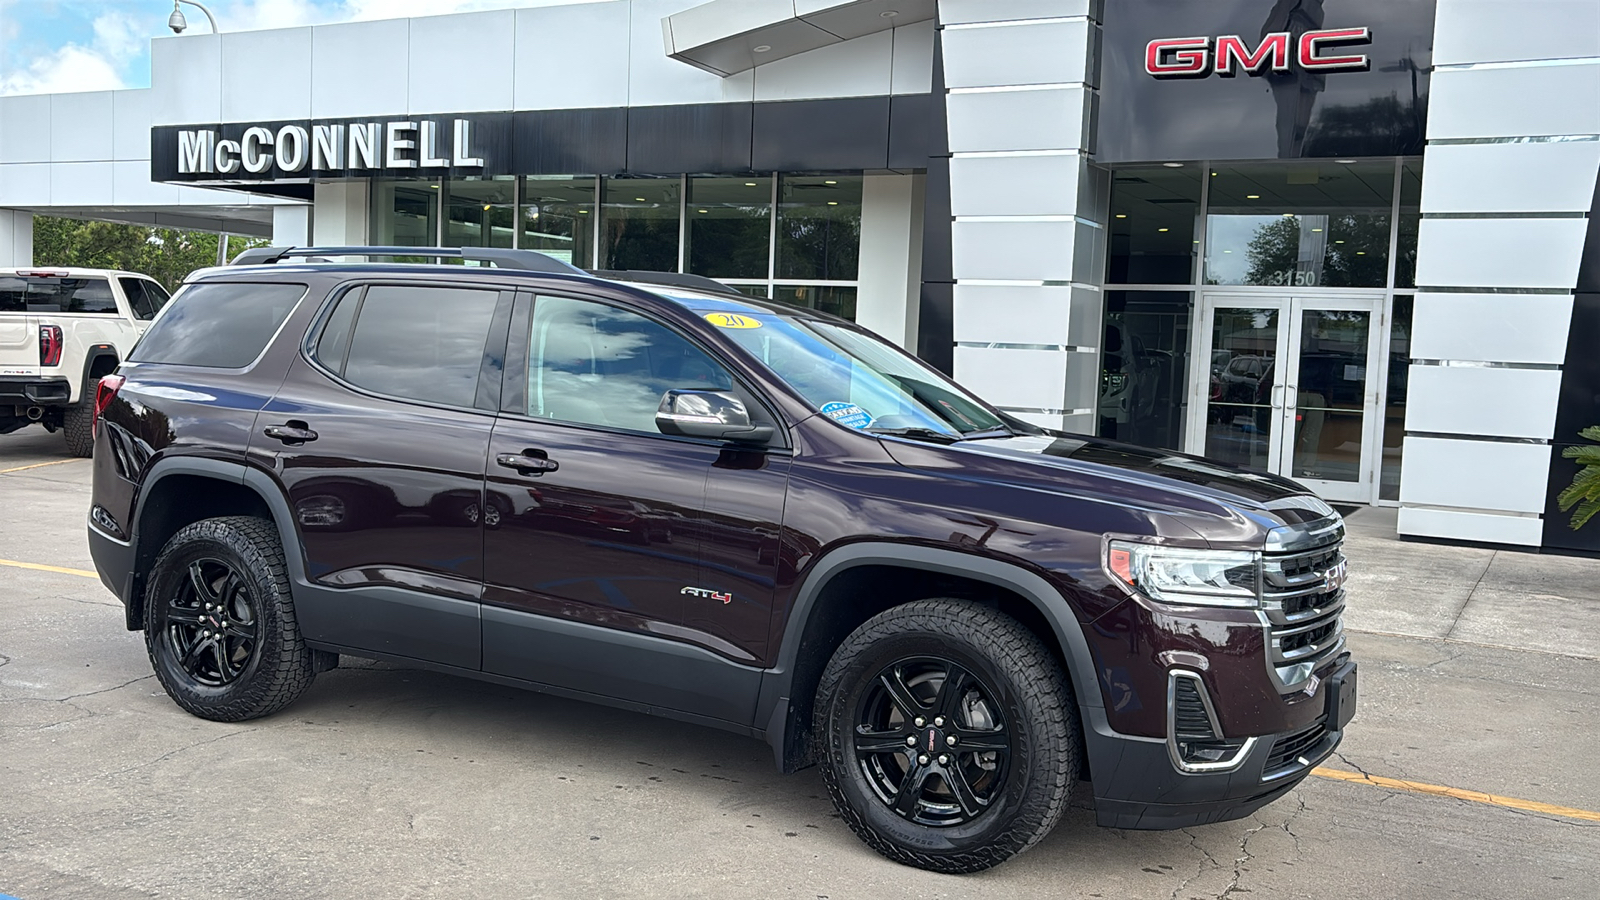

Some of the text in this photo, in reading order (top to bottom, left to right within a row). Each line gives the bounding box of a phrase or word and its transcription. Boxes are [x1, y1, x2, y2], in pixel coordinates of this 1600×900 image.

[1145, 27, 1370, 77] GMC
[177, 119, 484, 174] McCONNELL
[1273, 270, 1316, 286] 3150
[718, 314, 745, 327] 20
[680, 586, 732, 604] AT4
